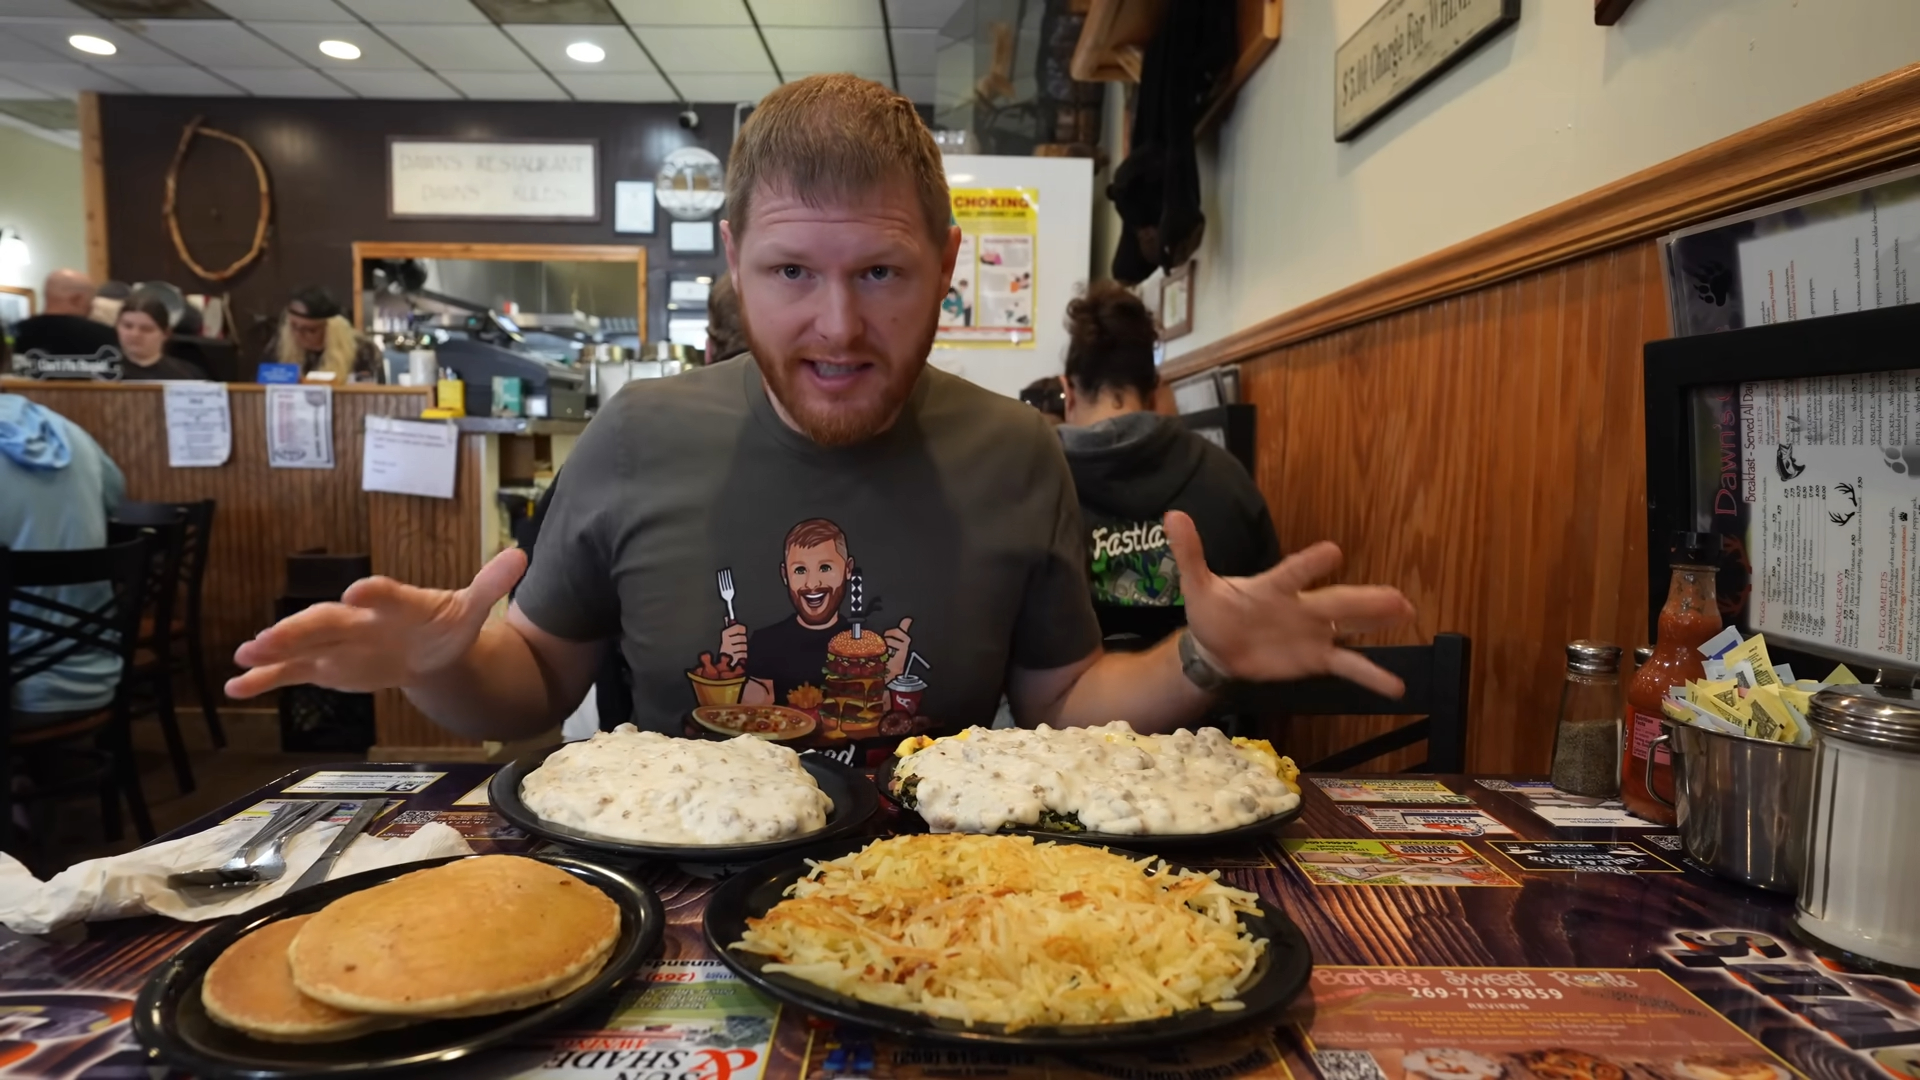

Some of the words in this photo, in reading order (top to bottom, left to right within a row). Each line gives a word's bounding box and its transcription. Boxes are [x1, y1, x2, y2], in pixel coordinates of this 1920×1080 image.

[1370, 26, 1404, 84] Charge
[1406, 12, 1426, 55] For
[475, 154, 583, 173] RESTAURANT
[954, 197, 1029, 208] CHOKING
[1742, 383, 1758, 401] Day
[1740, 404, 1753, 416] All
[1740, 418, 1755, 450] Served
[1713, 410, 1737, 516] Dawn's
[1742, 458, 1756, 502] Breakfast
[1092, 521, 1170, 560] Fastla
[1527, 855, 1579, 866] CHAIR
[1595, 856, 1645, 866] TABLE
[645, 972, 696, 982] (269)
[1440, 968, 1538, 988] Sweet
[1407, 986, 1564, 1000] 269-719-9859
[1467, 1002, 1530, 1010] REVIEWS
[542, 1050, 689, 1070] SHADE
